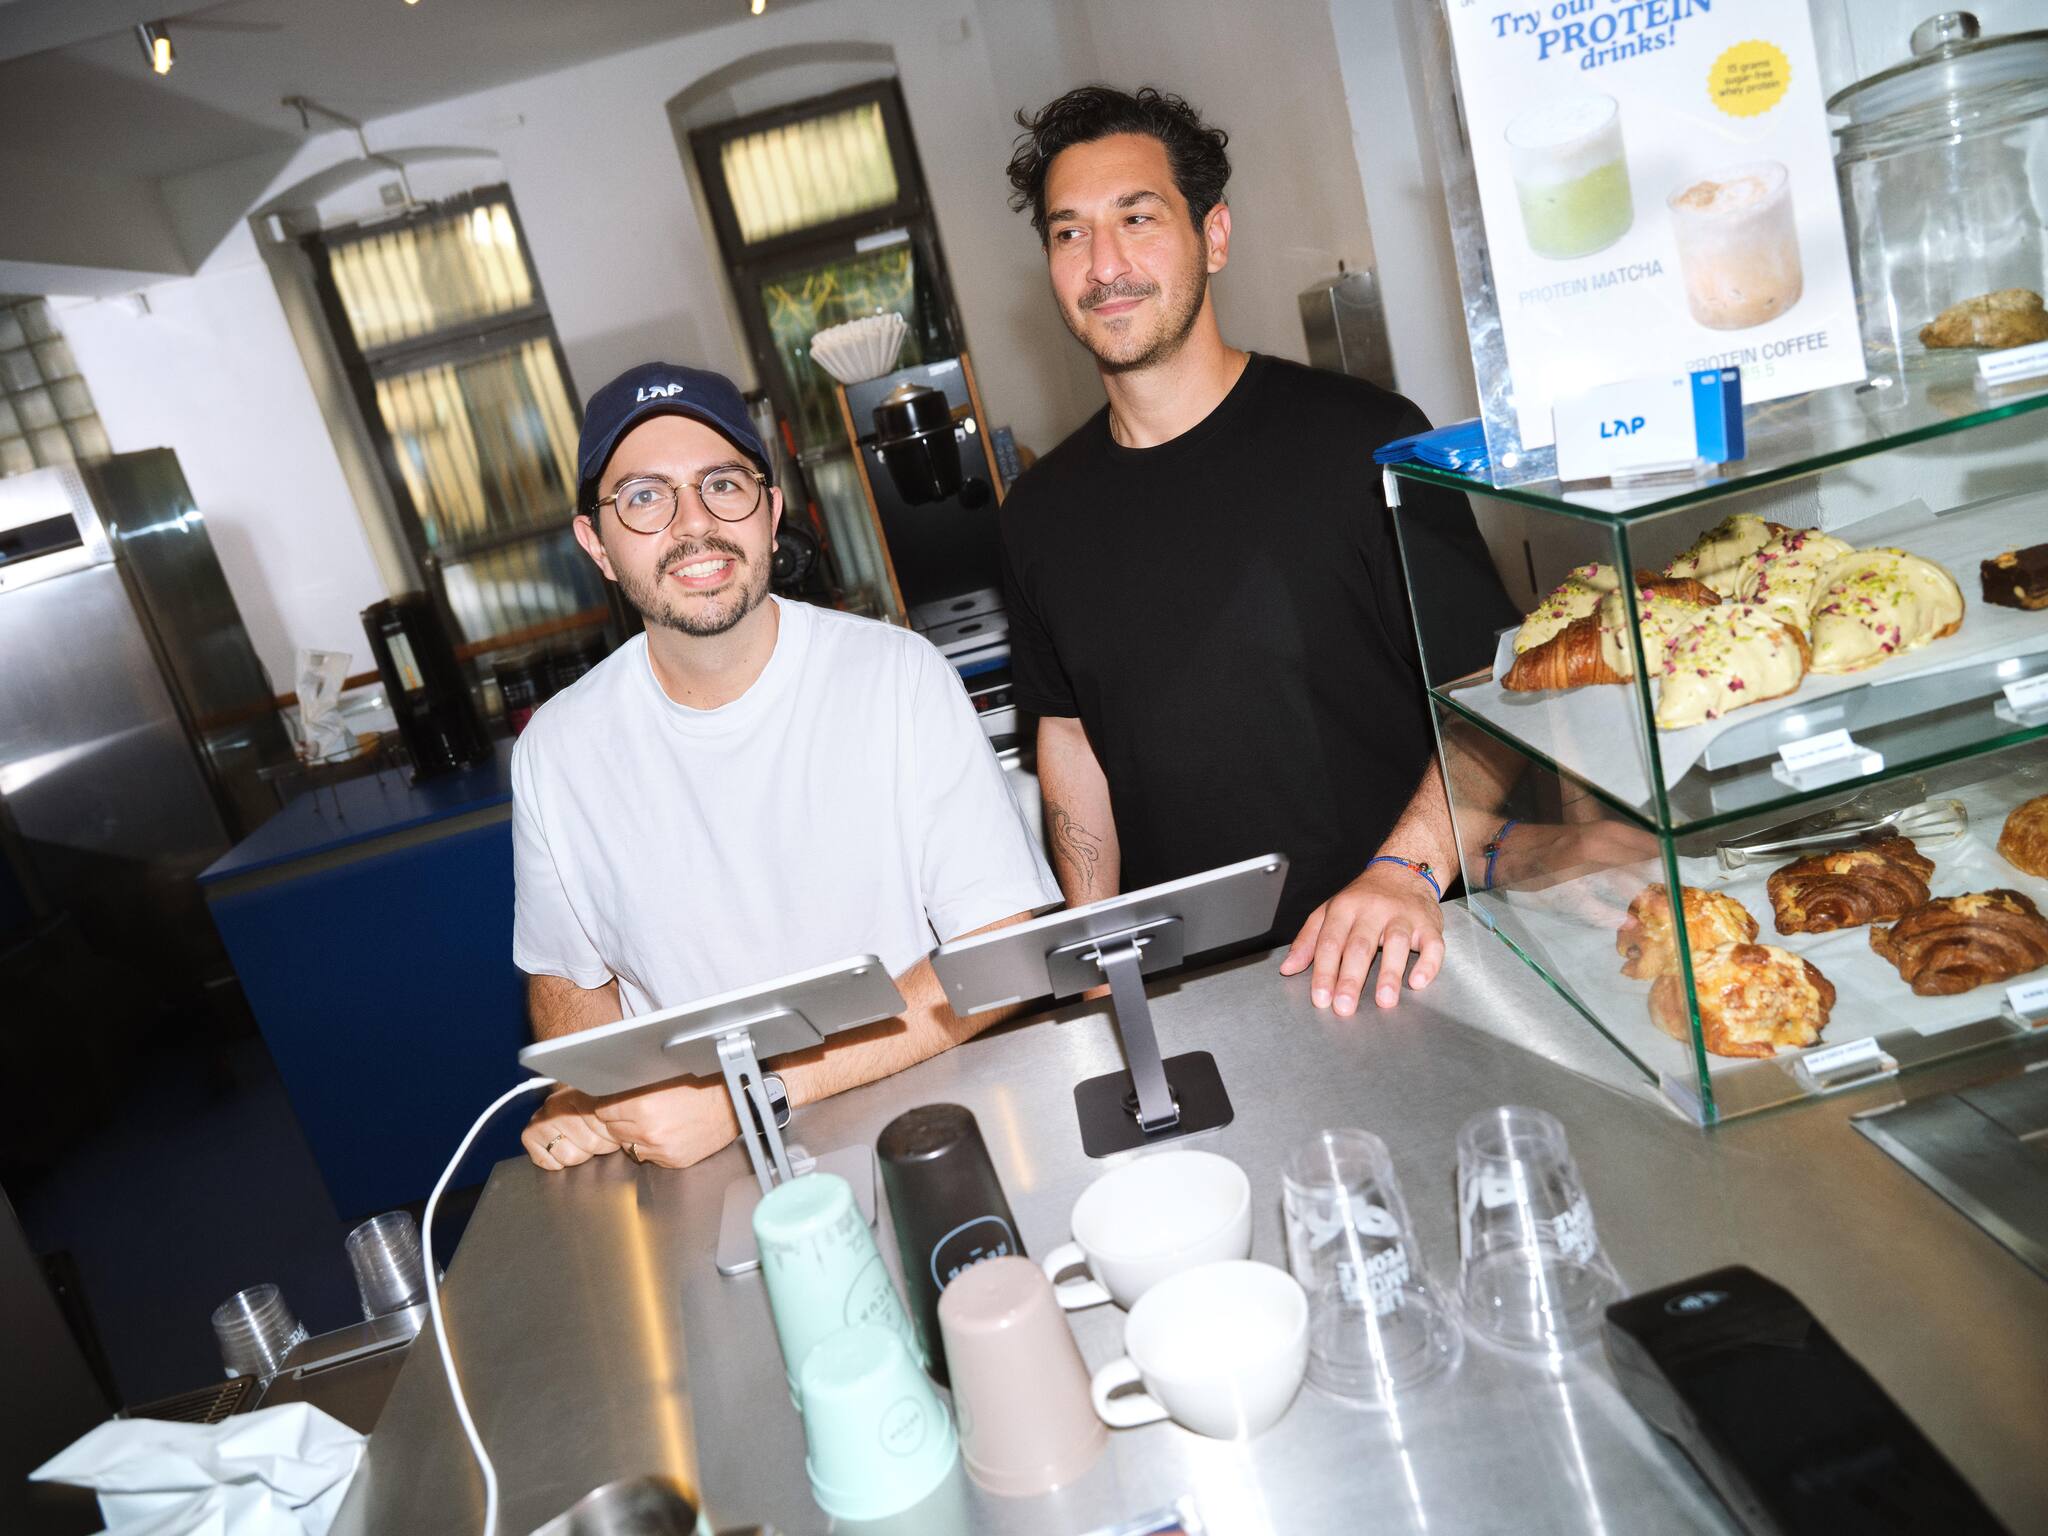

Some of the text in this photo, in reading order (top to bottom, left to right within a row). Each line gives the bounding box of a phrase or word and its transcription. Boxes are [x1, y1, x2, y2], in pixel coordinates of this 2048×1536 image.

[1491, 11, 1541, 38] Try
[1537, 0, 1712, 60] PROTEIN
[1580, 24, 1676, 70] drinks!
[1519, 259, 1664, 305] PROTEIN MATCHA
[1685, 347, 1758, 373] PROTEIN
[1762, 331, 1829, 361] COFFEE
